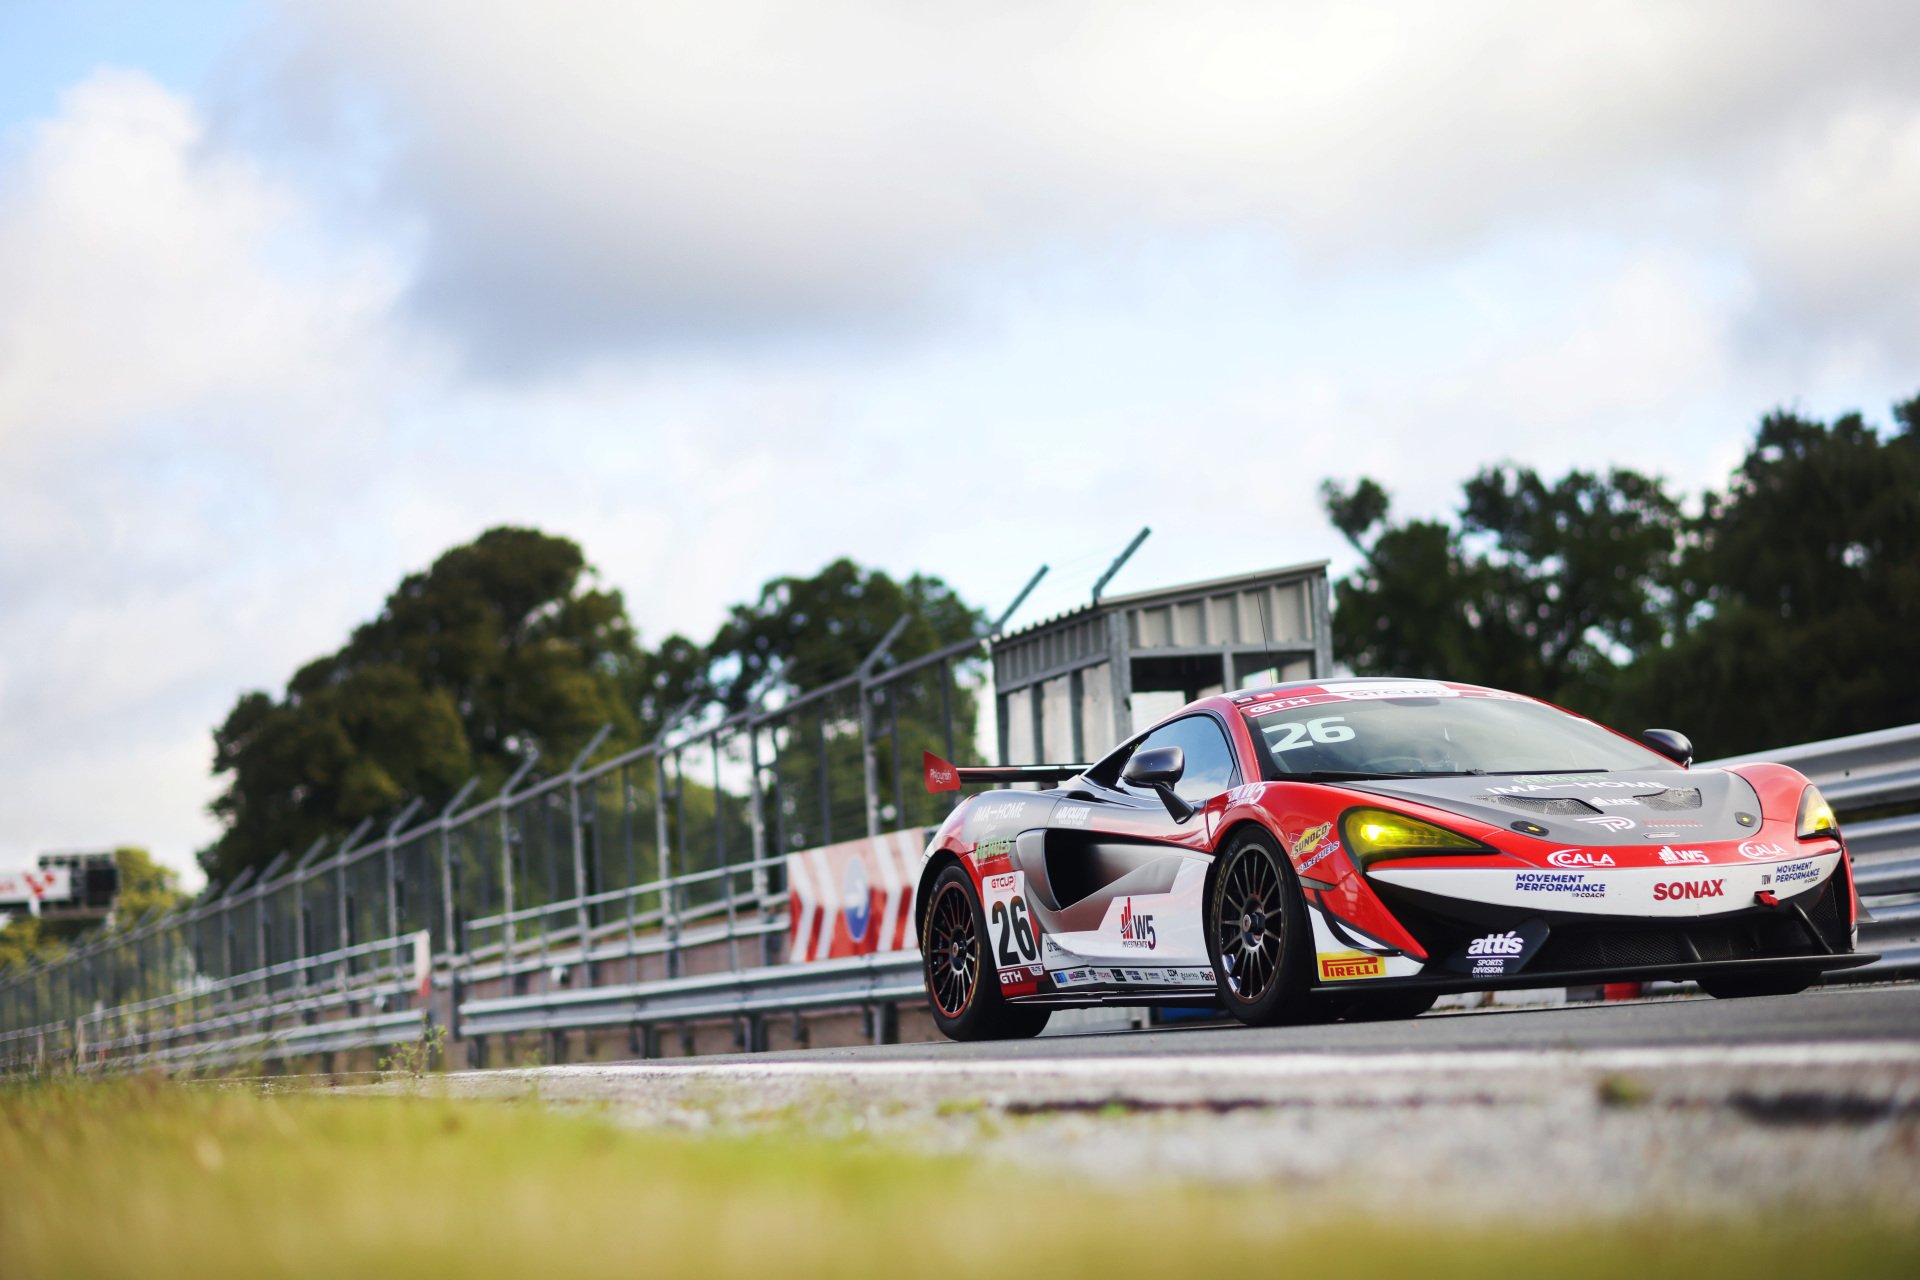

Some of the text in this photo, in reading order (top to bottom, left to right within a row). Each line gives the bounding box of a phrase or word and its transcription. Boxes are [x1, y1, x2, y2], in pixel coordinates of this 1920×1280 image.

[1249, 698, 1311, 713] GTH
[1261, 716, 1356, 753] 26
[1293, 825, 1329, 856] SUNOCO
[1674, 850, 1710, 864] W5
[1744, 843, 1786, 857] CALA
[1557, 853, 1615, 865] CALA
[1776, 861, 1813, 874] MOVEMENT
[1515, 873, 1585, 883] MOVEMENT
[1775, 867, 1821, 883] PERFORMANCE
[1515, 882, 1606, 892] PERFORMANCE
[1653, 878, 1724, 901] SONAX
[991, 895, 1037, 967] 26
[1132, 914, 1157, 950] W5
[1321, 956, 1379, 978] PIRELLI
[1472, 966, 1504, 974] DIVISION
[1000, 970, 1023, 984] GTH
